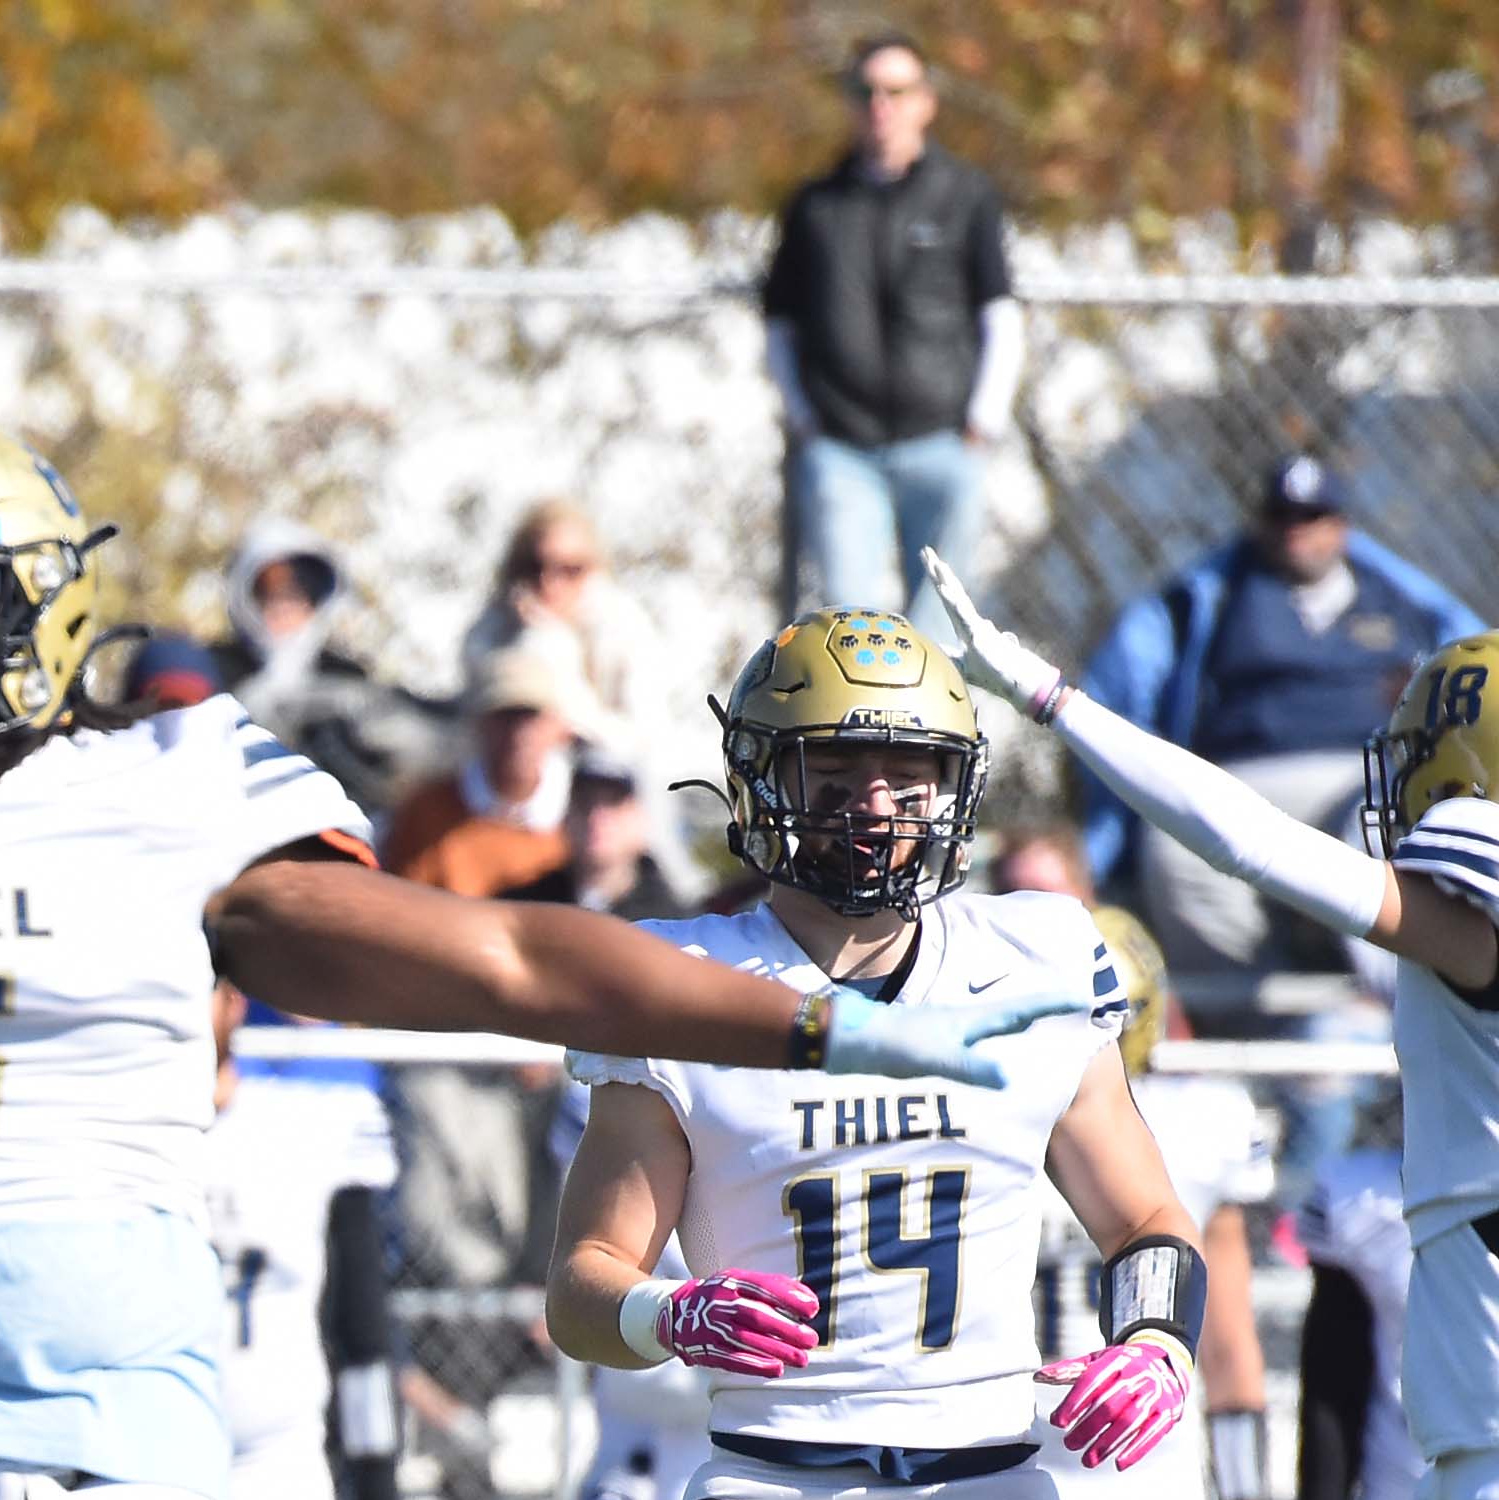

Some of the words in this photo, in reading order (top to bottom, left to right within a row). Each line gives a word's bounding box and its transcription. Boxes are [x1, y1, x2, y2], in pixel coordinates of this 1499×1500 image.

[854, 710, 921, 727] THIEL
[1425, 664, 1489, 727] 18
[790, 1093, 969, 1151] THIEL
[780, 1163, 973, 1353] 14
